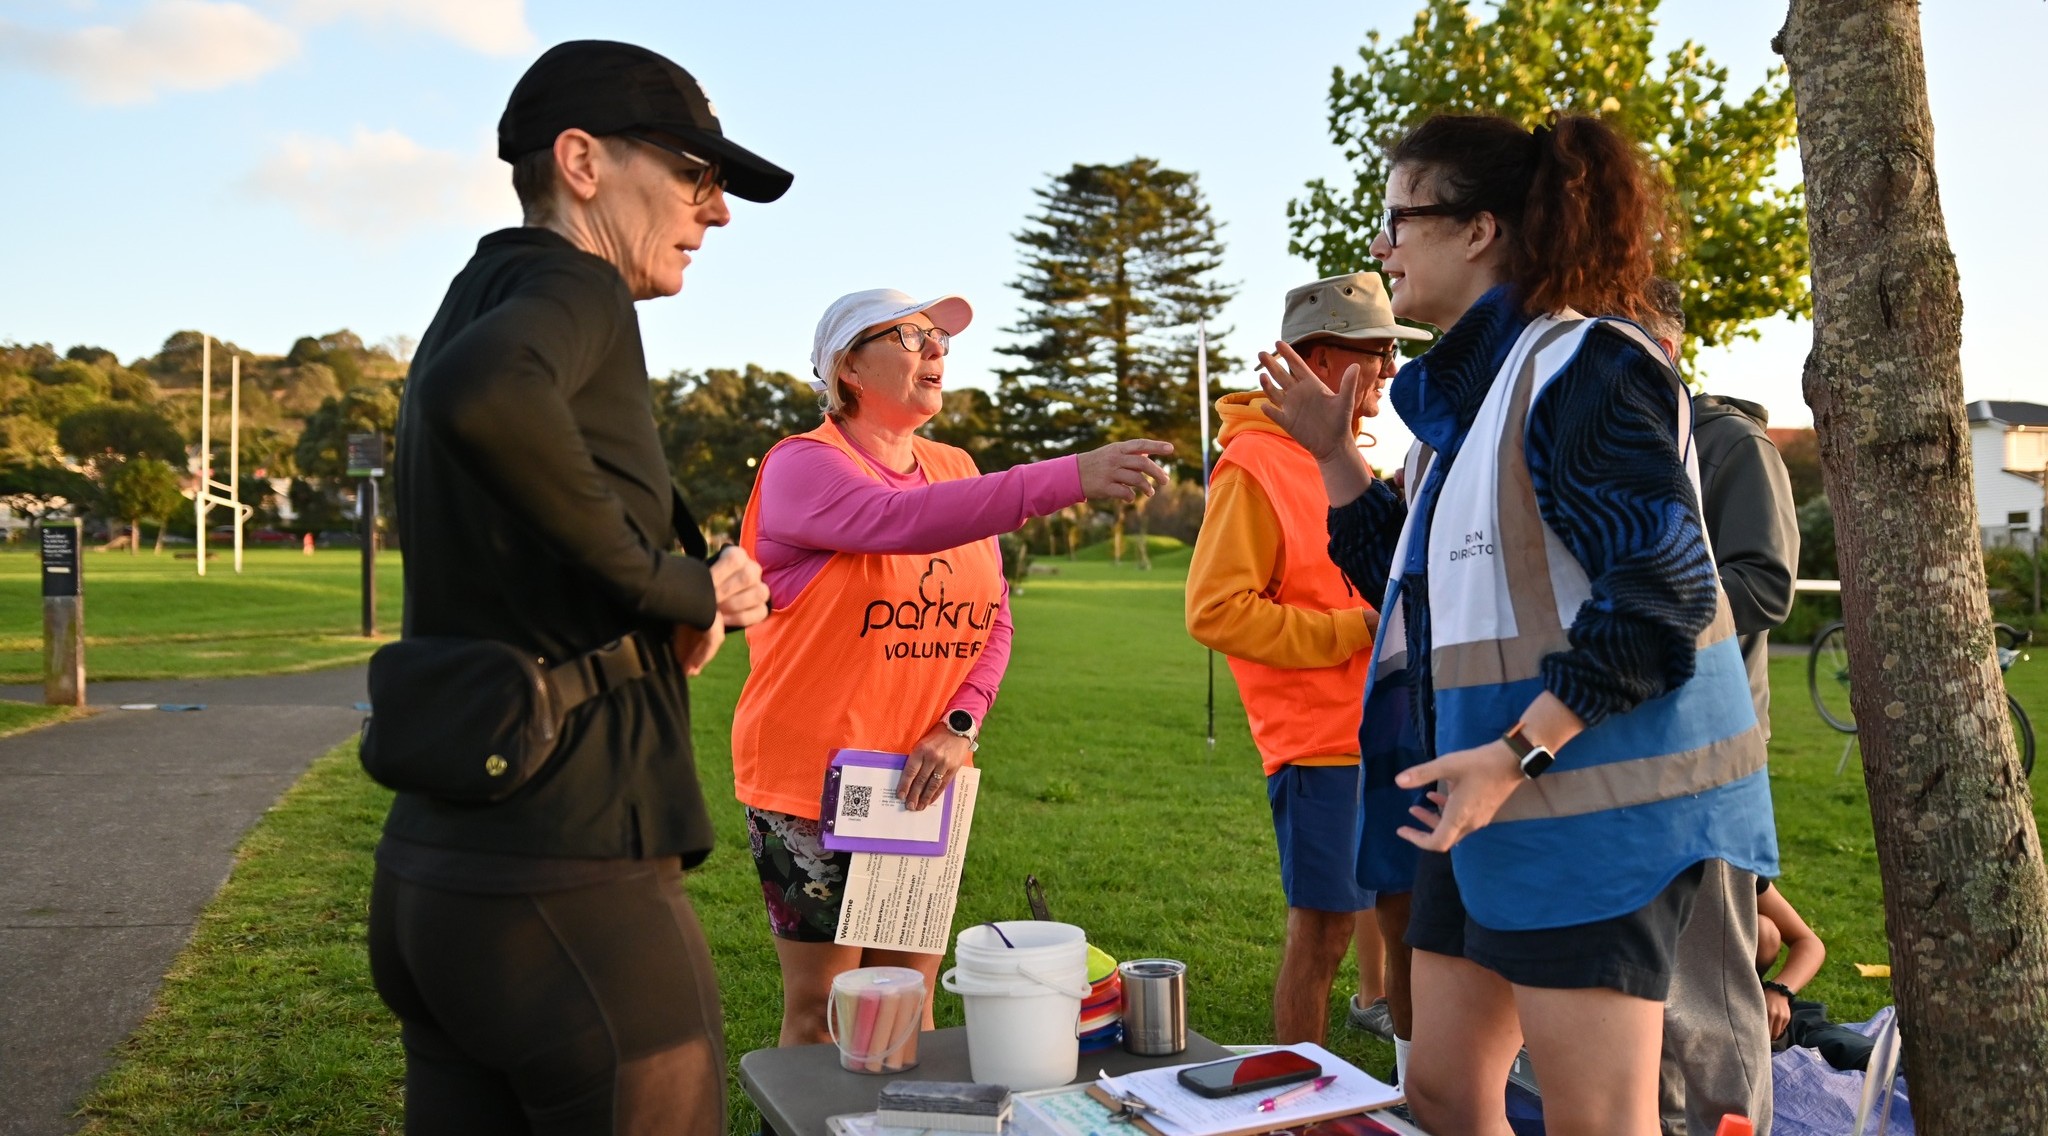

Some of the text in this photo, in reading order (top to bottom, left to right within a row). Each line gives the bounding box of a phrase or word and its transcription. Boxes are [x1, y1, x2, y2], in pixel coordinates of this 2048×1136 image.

[1466, 530, 1483, 544] RN
[1450, 544, 1494, 561] DIRCTO
[952, 804, 960, 832] experiences
[840, 899, 853, 938] Welcome
[923, 893, 933, 926] description
